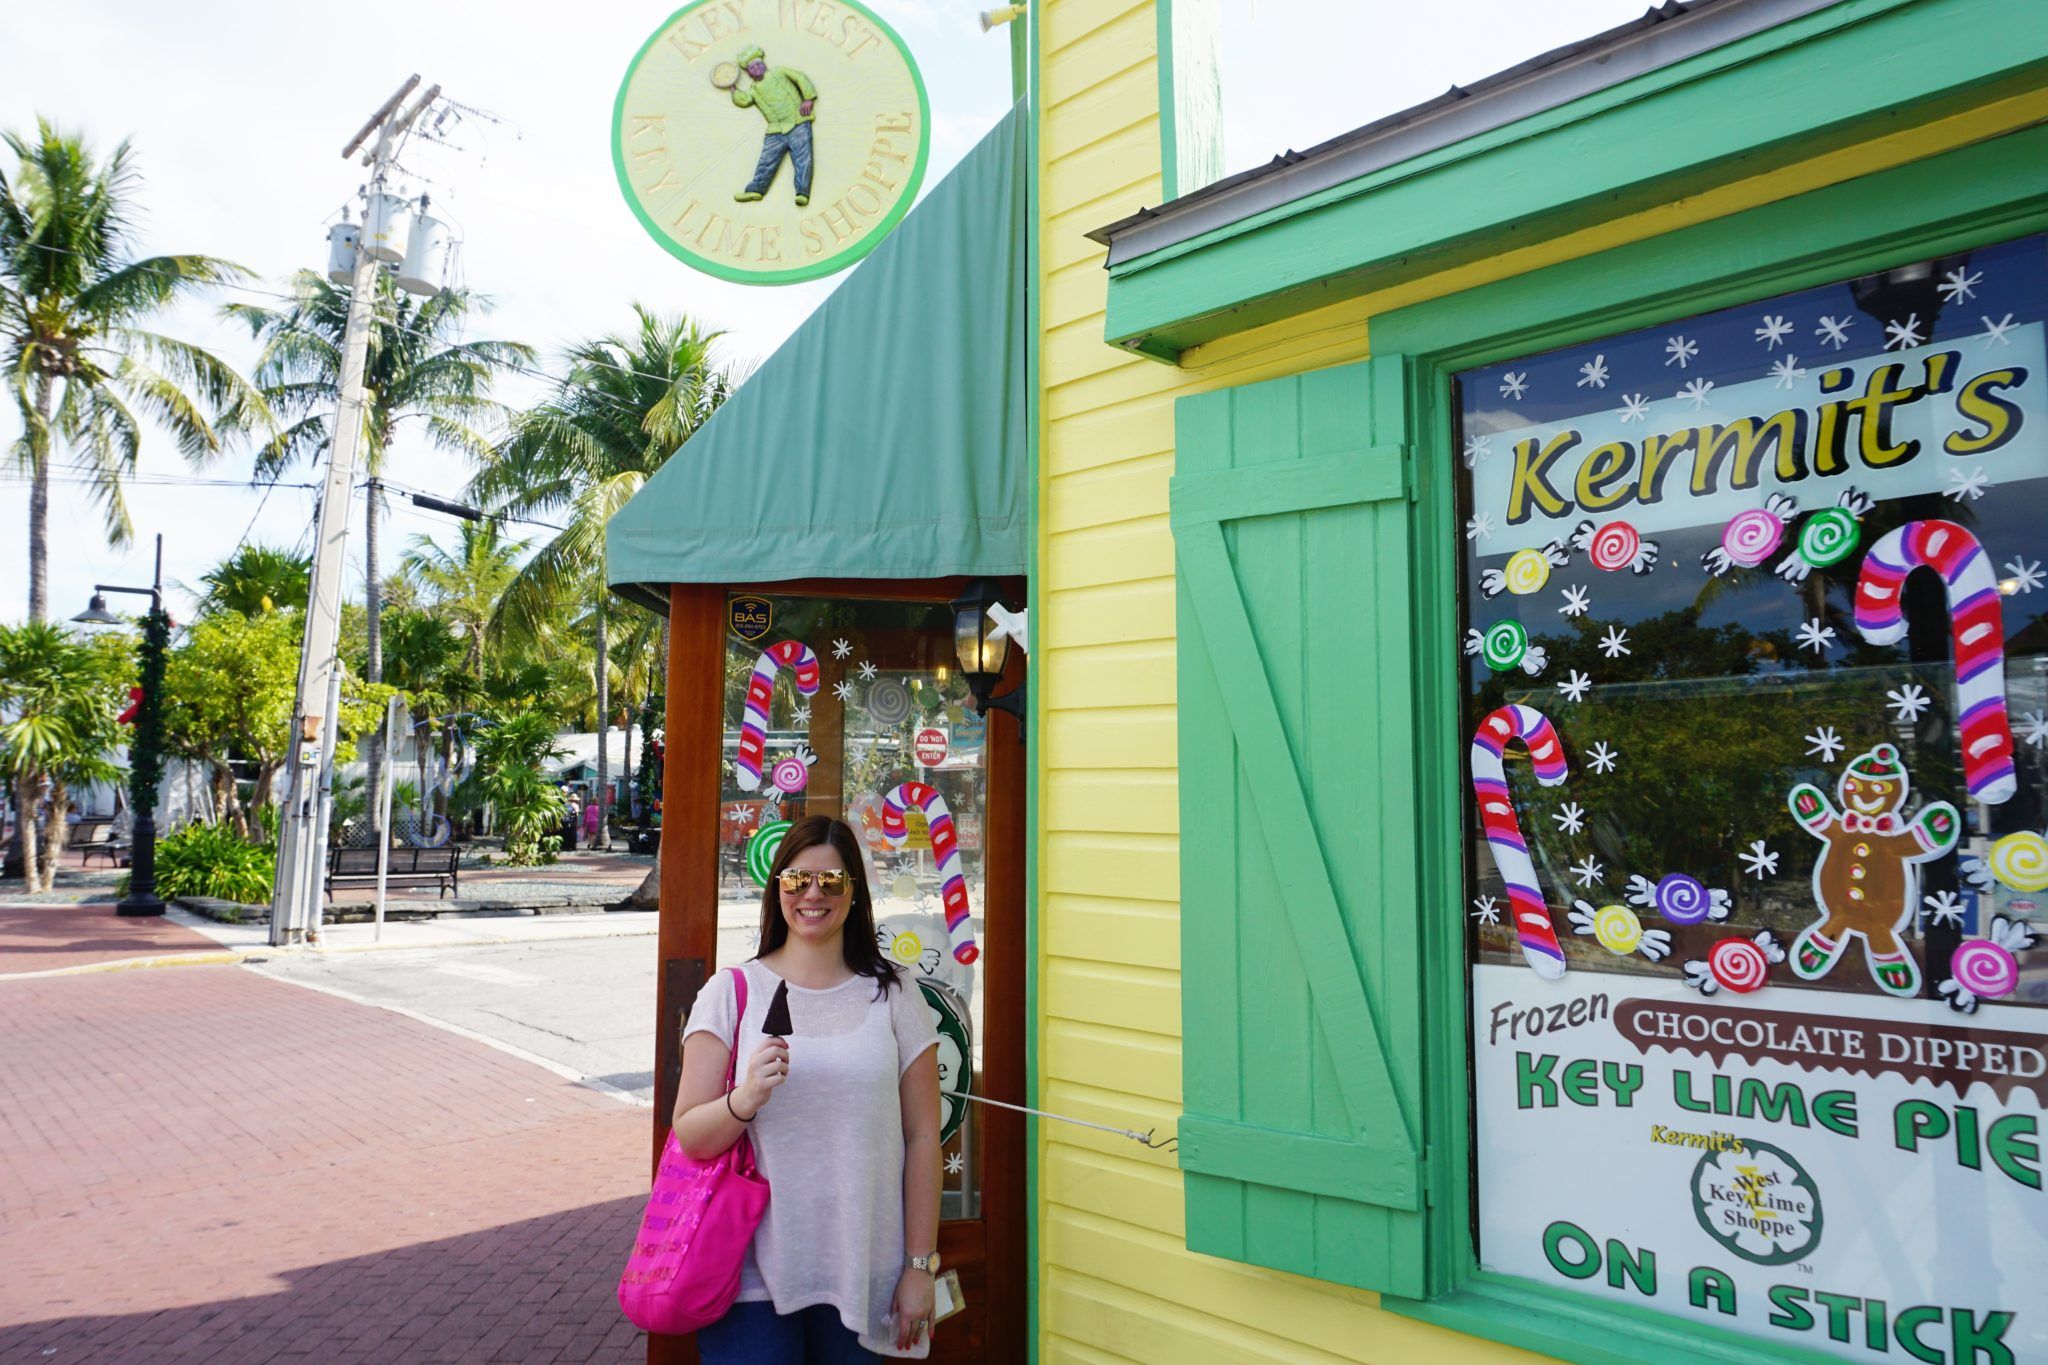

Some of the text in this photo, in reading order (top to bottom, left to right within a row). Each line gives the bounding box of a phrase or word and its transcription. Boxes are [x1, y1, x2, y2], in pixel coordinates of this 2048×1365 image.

[667, 0, 883, 62] KEY WEST
[630, 111, 913, 262] KEY LIME SHOPPE
[1505, 350, 2030, 526] Kermit's
[735, 612, 767, 624] BAS
[919, 735, 944, 743] DO NOT
[921, 752, 941, 760] ENTER
[1490, 993, 1609, 1046] Frozen
[1632, 1010, 2047, 1078] CHOCOLATE DIPPED
[1516, 1051, 2042, 1191] KEY LIME PIE
[1651, 1124, 1745, 1154] Kermit's
[1709, 1184, 1807, 1214] Key Lime
[1733, 1170, 1782, 1191] West
[1724, 1209, 1796, 1238] Shoppe
[1542, 1220, 2017, 1365] ON A STICK
